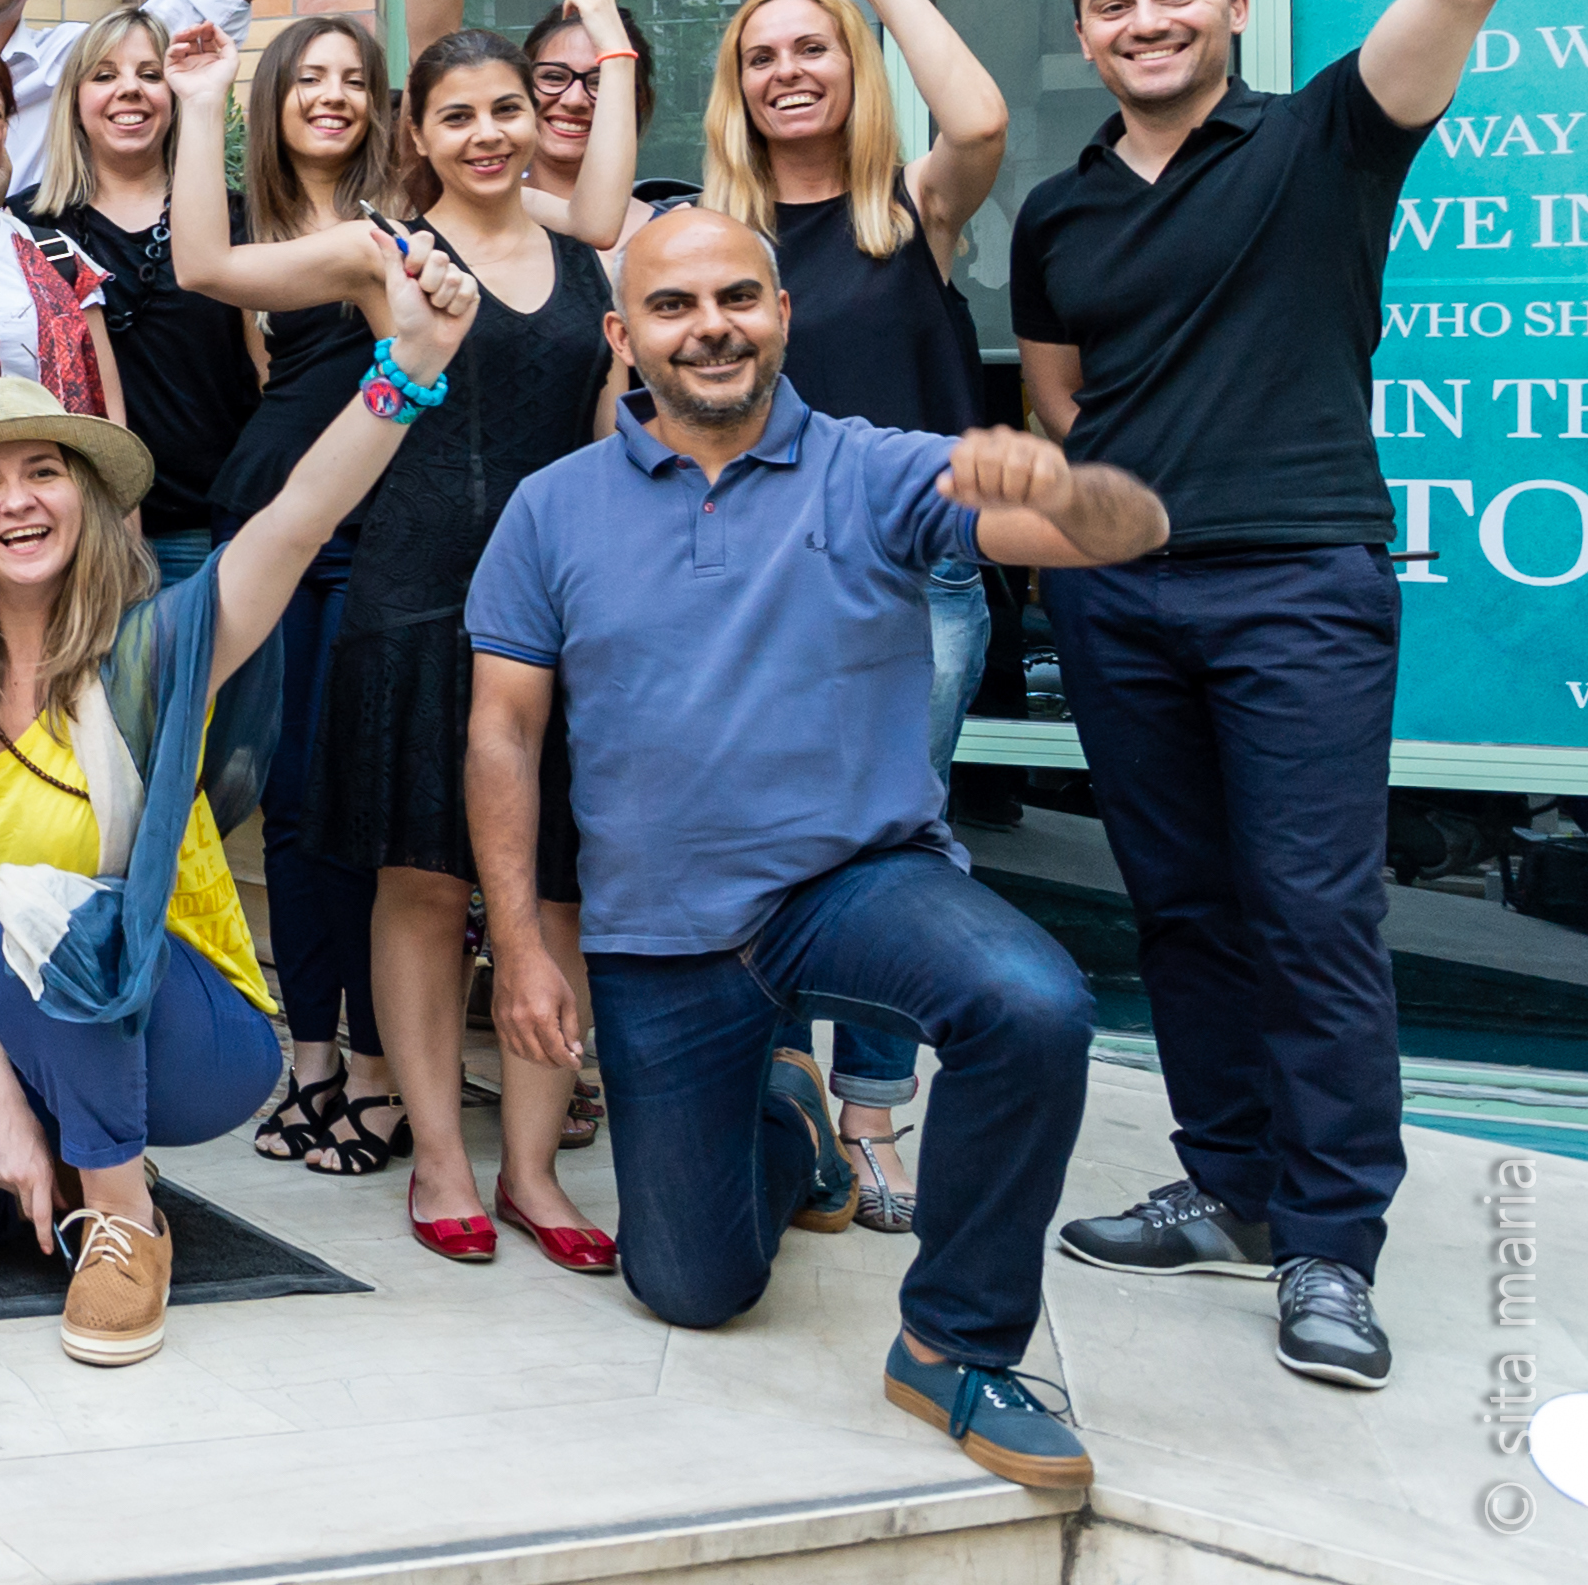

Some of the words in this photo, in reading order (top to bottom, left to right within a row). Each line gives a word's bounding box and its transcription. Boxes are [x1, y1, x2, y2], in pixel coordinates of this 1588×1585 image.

[1435, 113, 1587, 159] WAY
[1390, 195, 1513, 251] WE
[1382, 301, 1512, 339] WHO
[1372, 378, 1471, 439] IN
